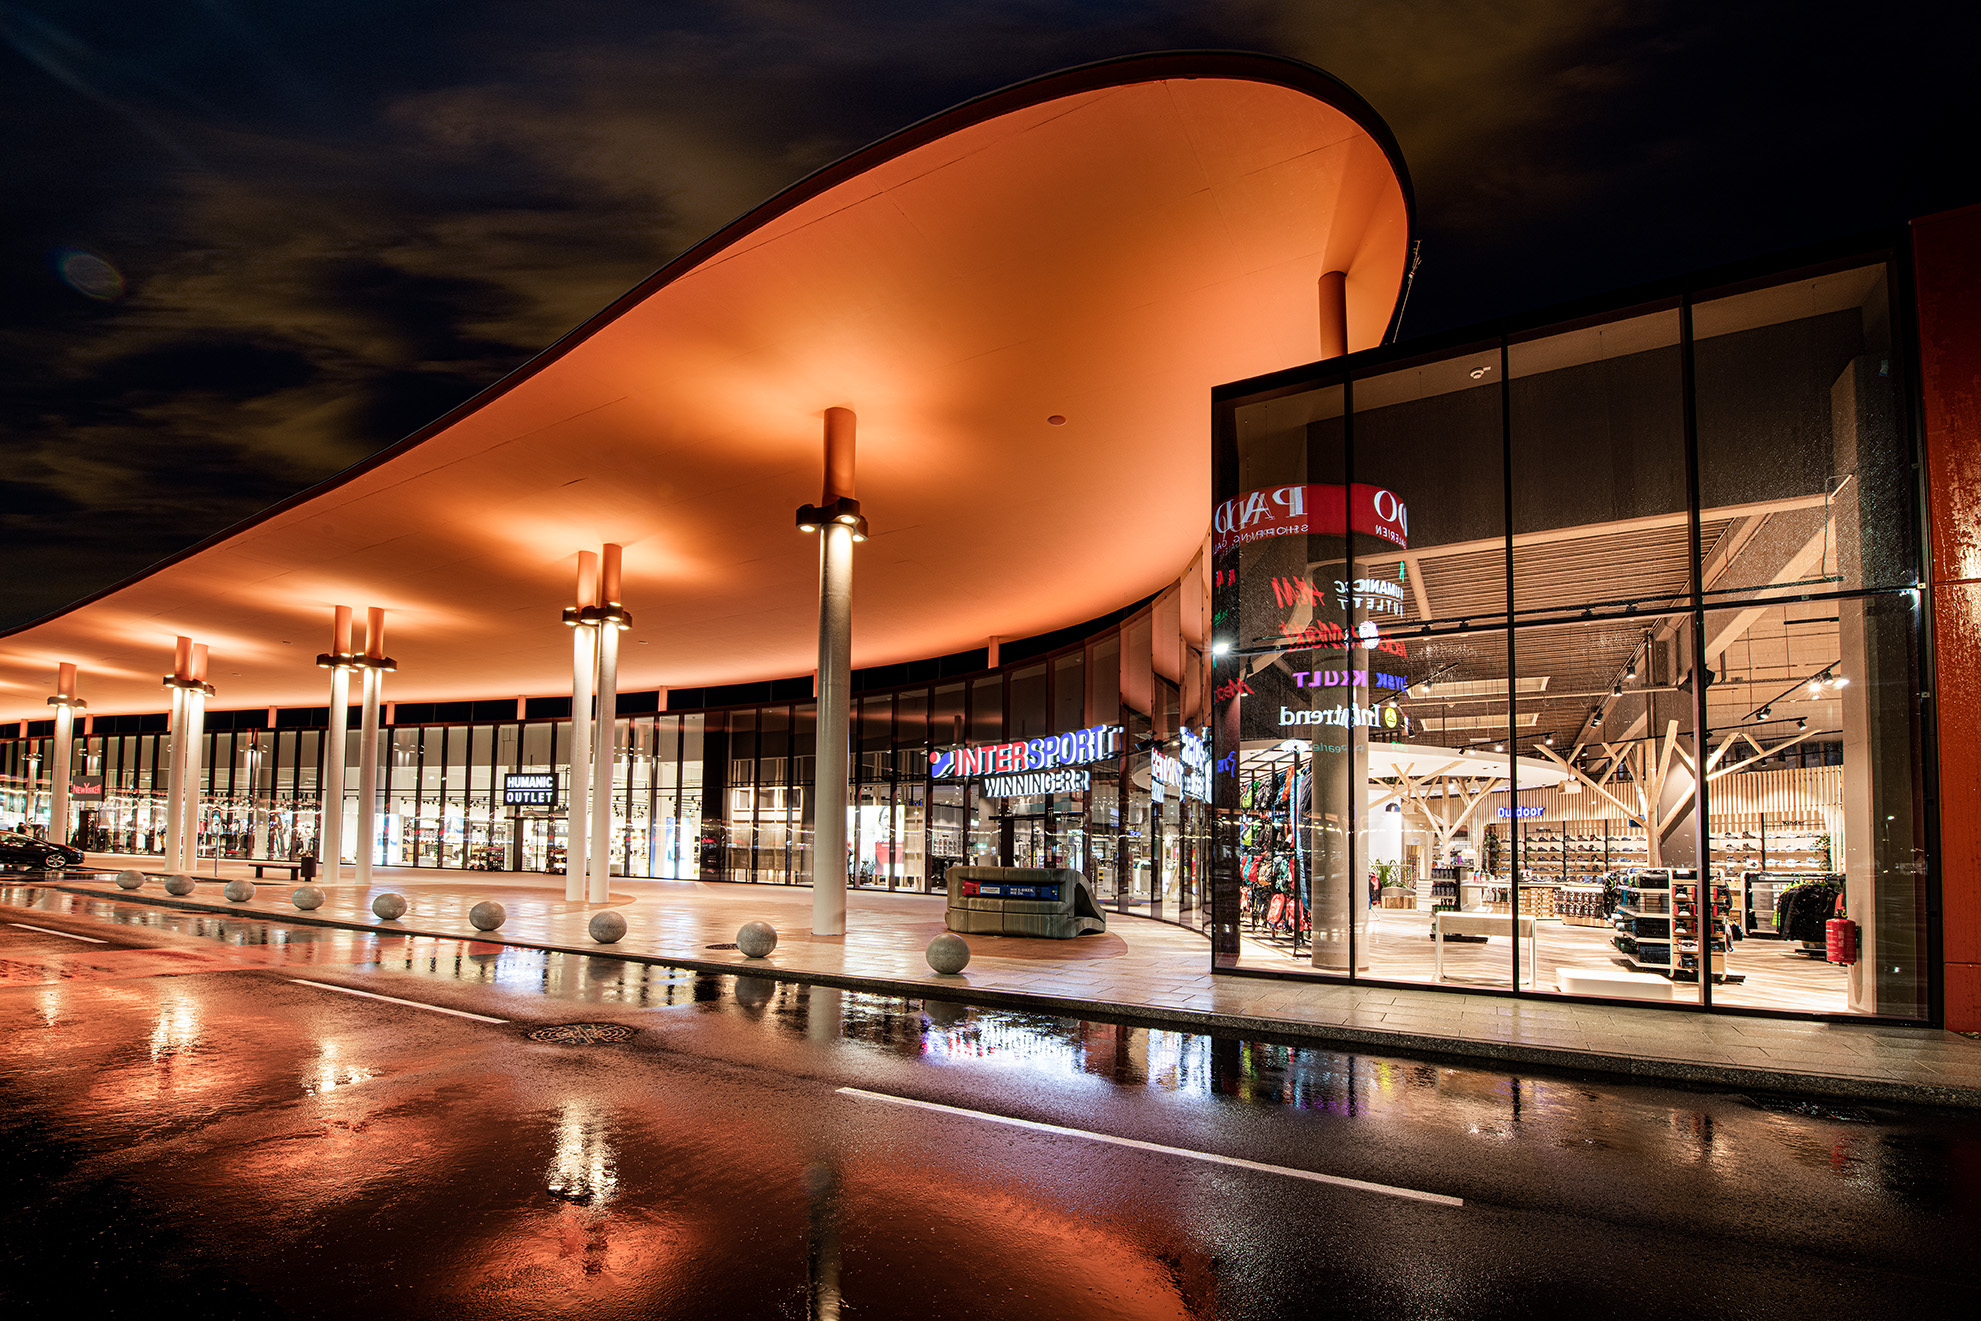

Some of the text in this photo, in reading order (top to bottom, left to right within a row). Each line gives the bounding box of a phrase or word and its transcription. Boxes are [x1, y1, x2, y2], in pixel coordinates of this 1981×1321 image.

[954, 724, 1109, 777] INTERSPORT
[506, 776, 553, 788] HUMANIC
[984, 769, 1090, 799] WINNINGER
[506, 792, 553, 803] OUTLET
[1497, 805, 1545, 818] Oudoor
